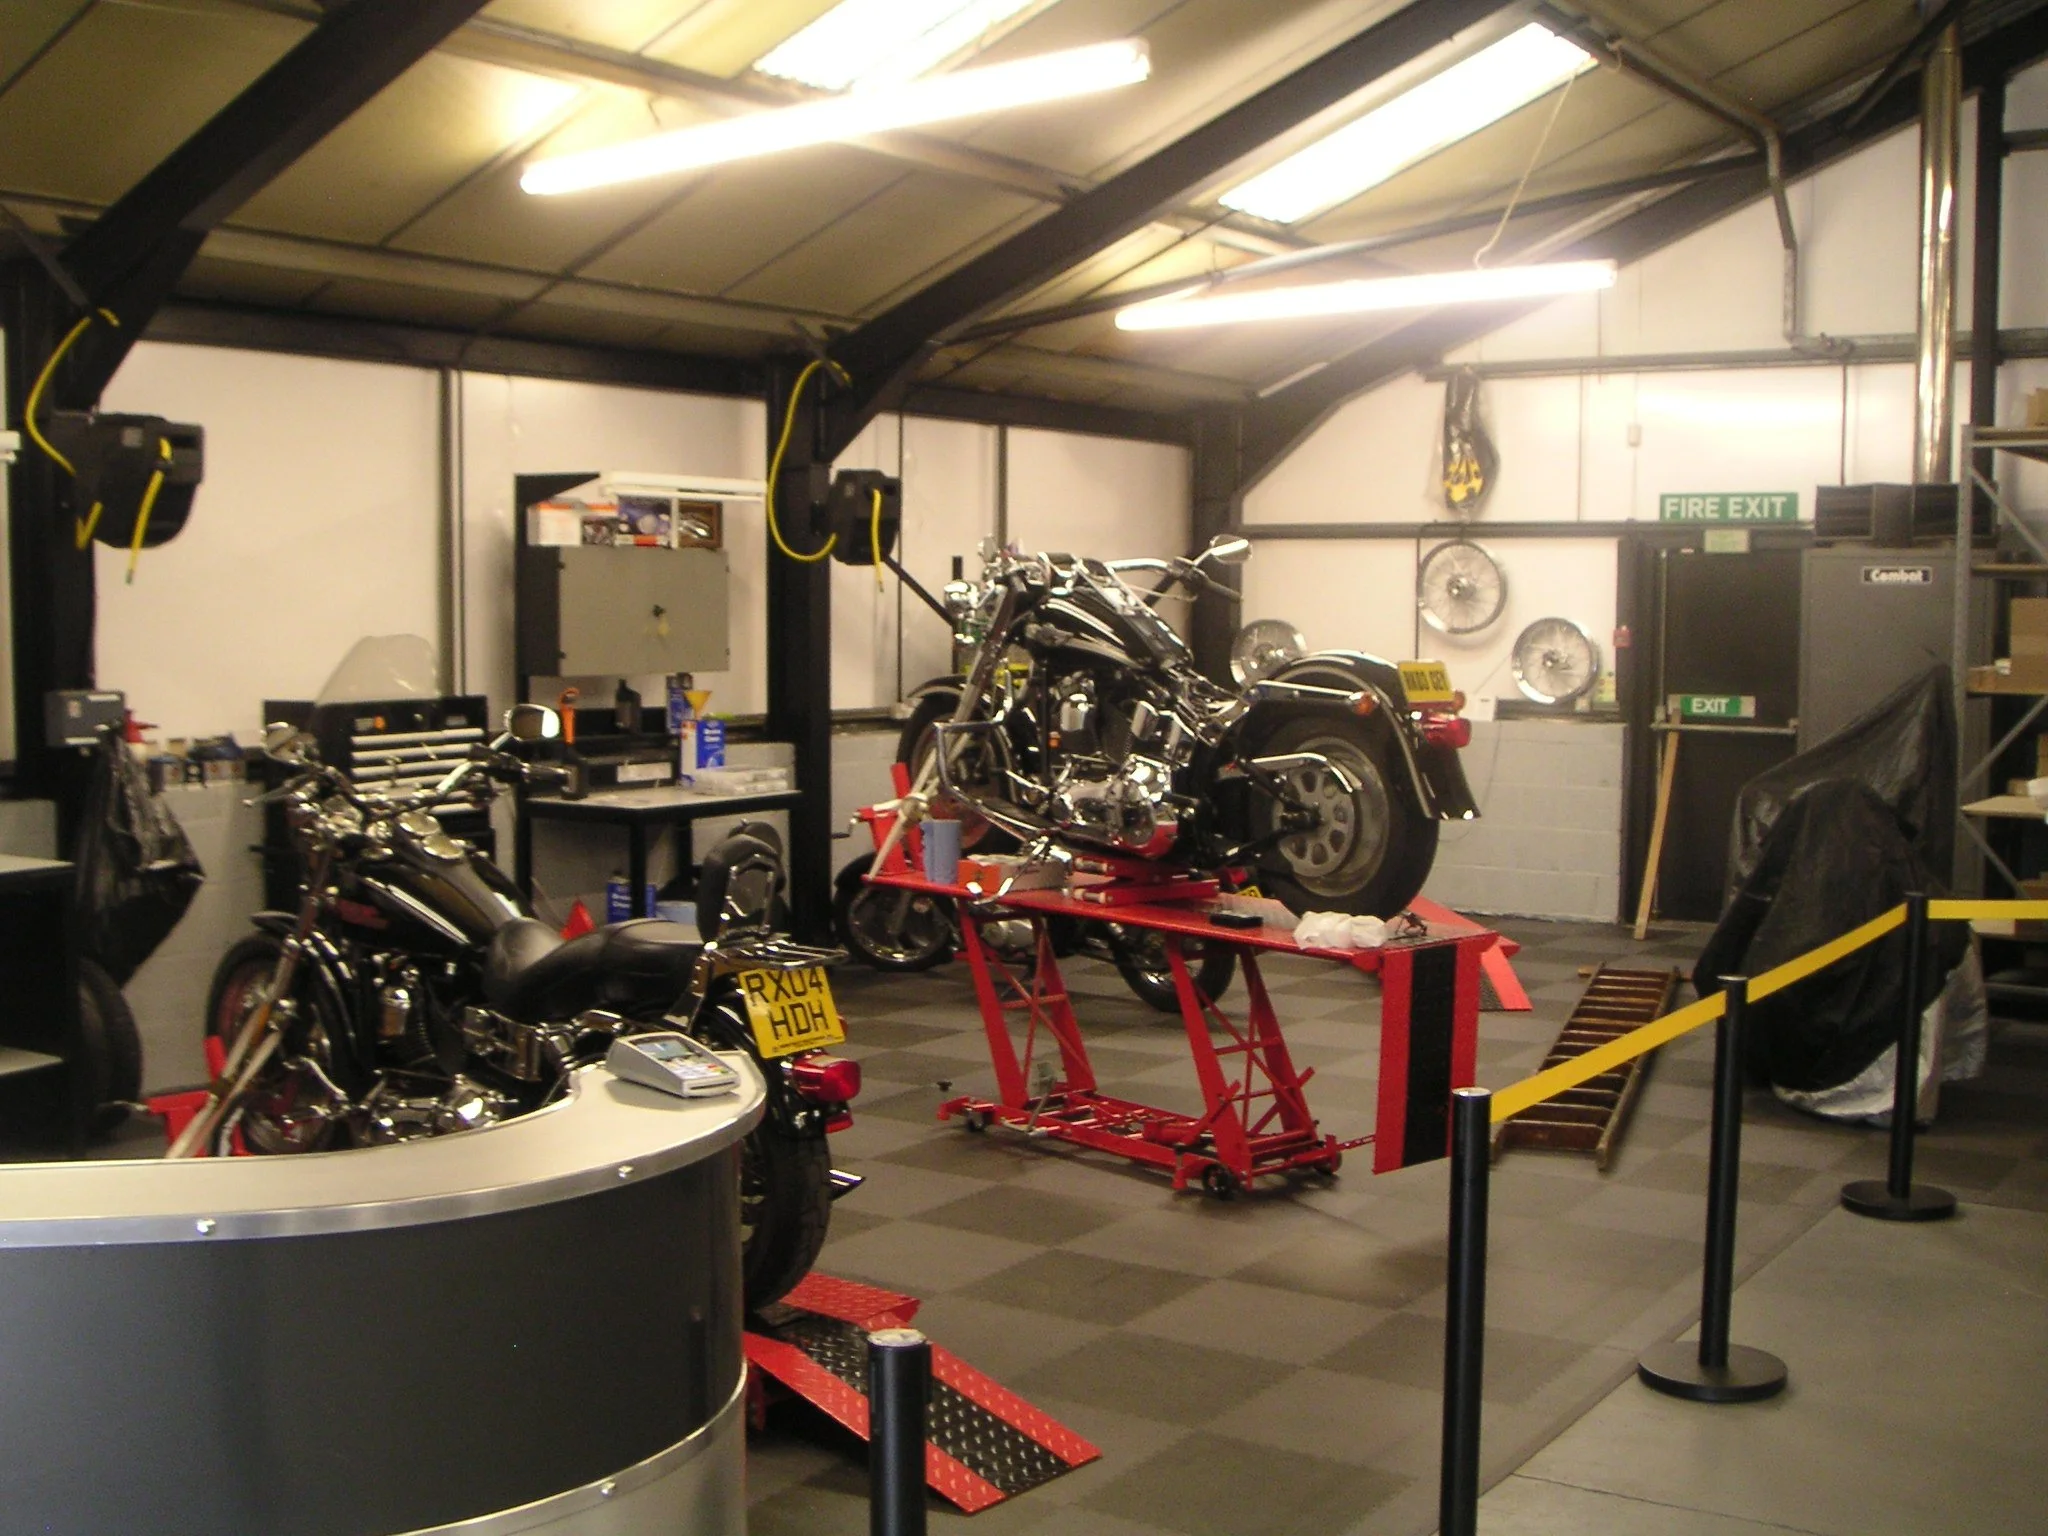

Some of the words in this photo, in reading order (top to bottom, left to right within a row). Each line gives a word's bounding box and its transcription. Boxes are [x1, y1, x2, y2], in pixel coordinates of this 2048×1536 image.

[1664, 497, 1720, 519] FIRE
[1728, 496, 1787, 519] EXIT
[1692, 697, 1730, 714] EXIT
[768, 1000, 830, 1040] HDH
